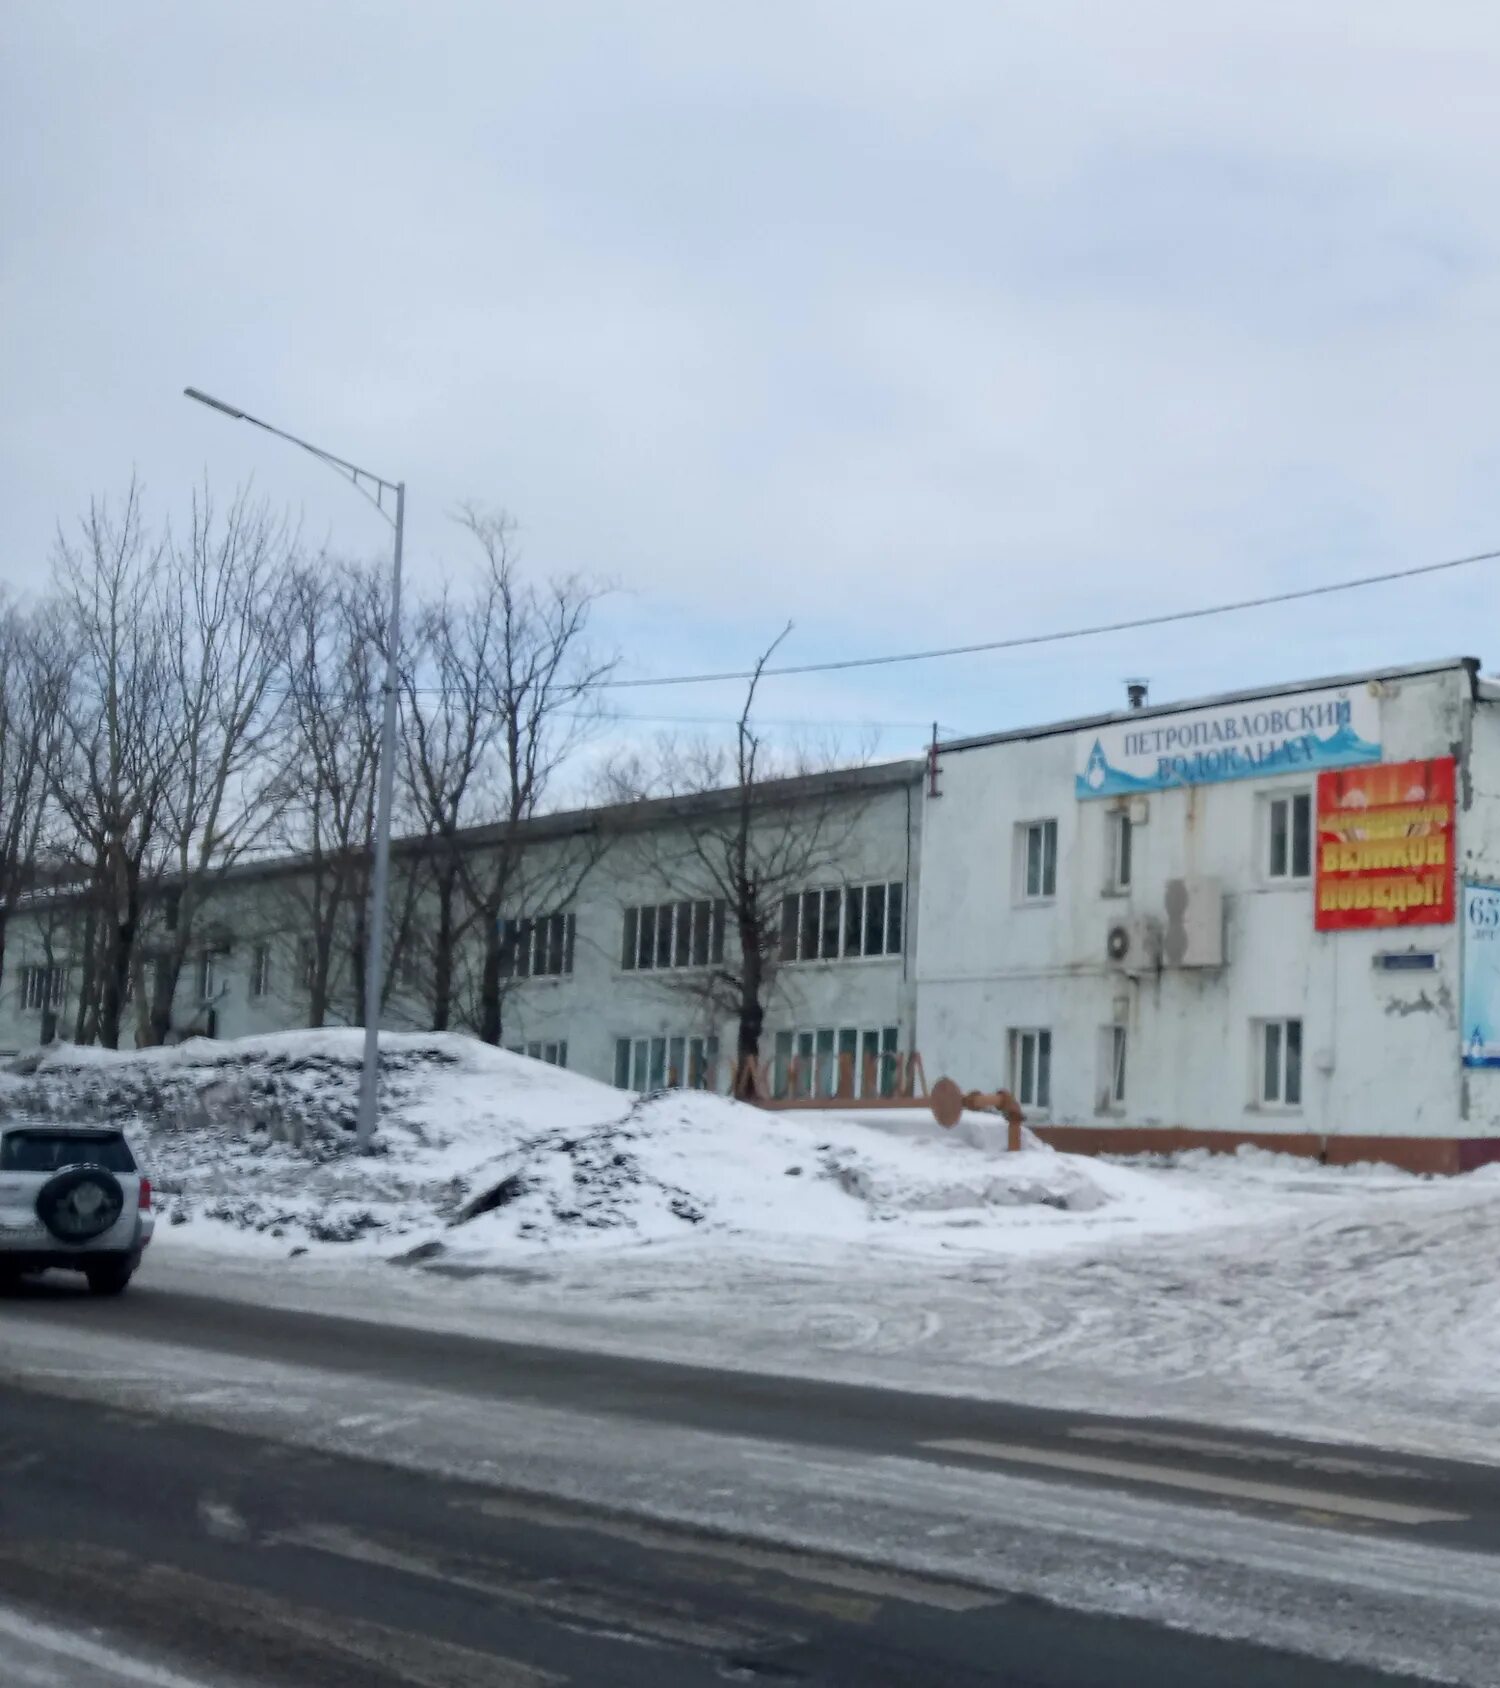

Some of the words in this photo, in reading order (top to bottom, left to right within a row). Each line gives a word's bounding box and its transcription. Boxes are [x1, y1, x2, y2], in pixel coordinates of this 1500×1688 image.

[1124, 691, 1351, 757] ПЕТРОПАВЛОВСКИЙ
[1157, 735, 1314, 781] ВОДОКАНАЛ
[1469, 896, 1500, 925] 65
